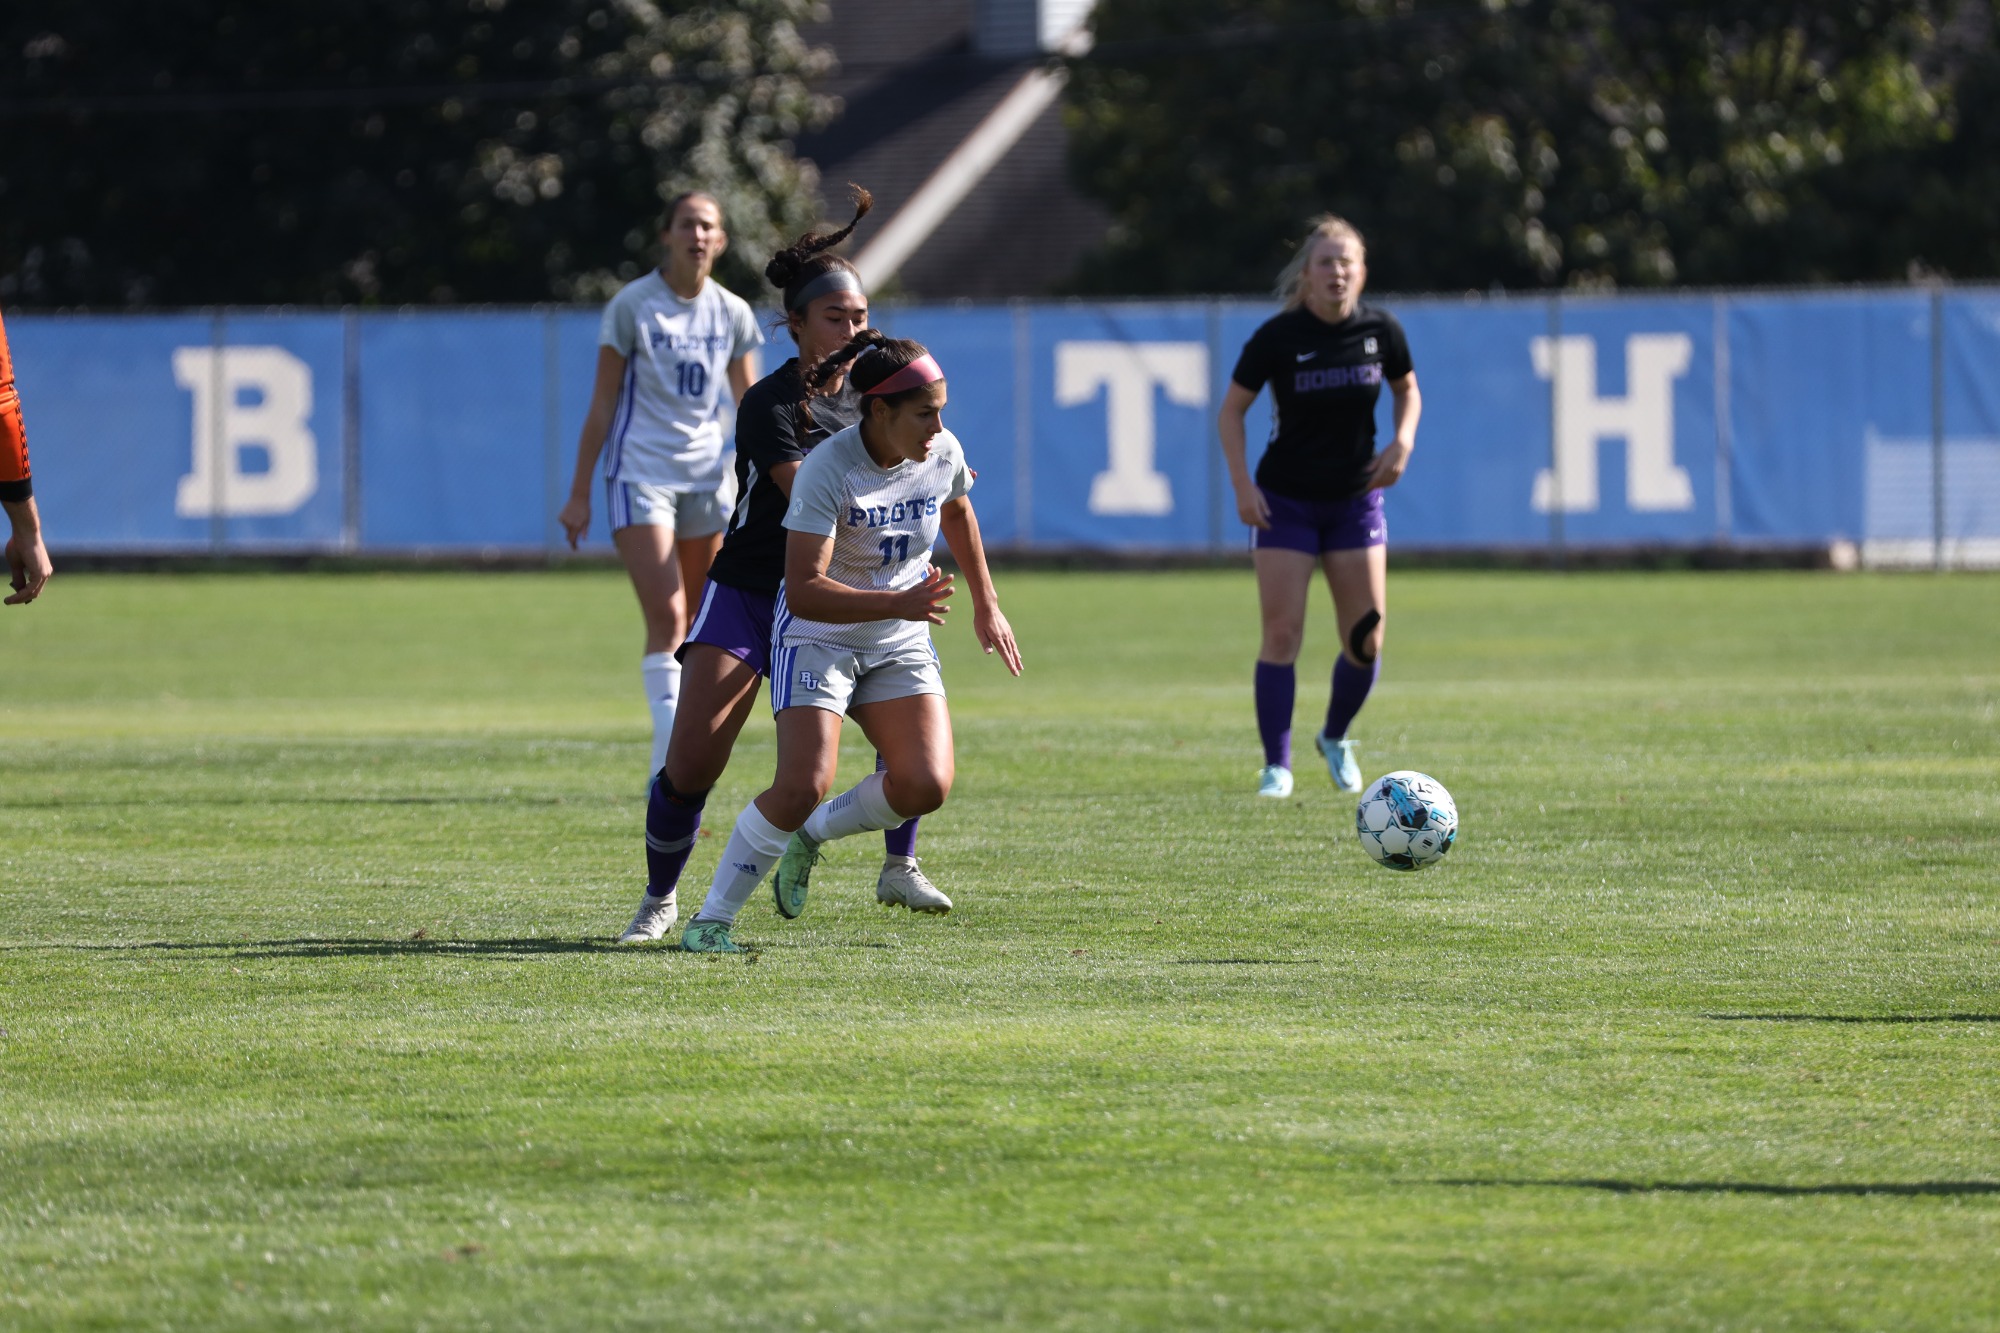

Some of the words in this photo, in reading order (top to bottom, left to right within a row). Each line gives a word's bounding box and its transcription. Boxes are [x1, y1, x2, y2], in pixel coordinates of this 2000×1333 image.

[676, 361, 705, 396] 10
[171, 346, 318, 518] B
[1053, 340, 1209, 516] T
[1529, 332, 1695, 514] H
[847, 495, 937, 528] PILOTS
[879, 535, 909, 566] 11
[800, 671, 819, 691] BU
